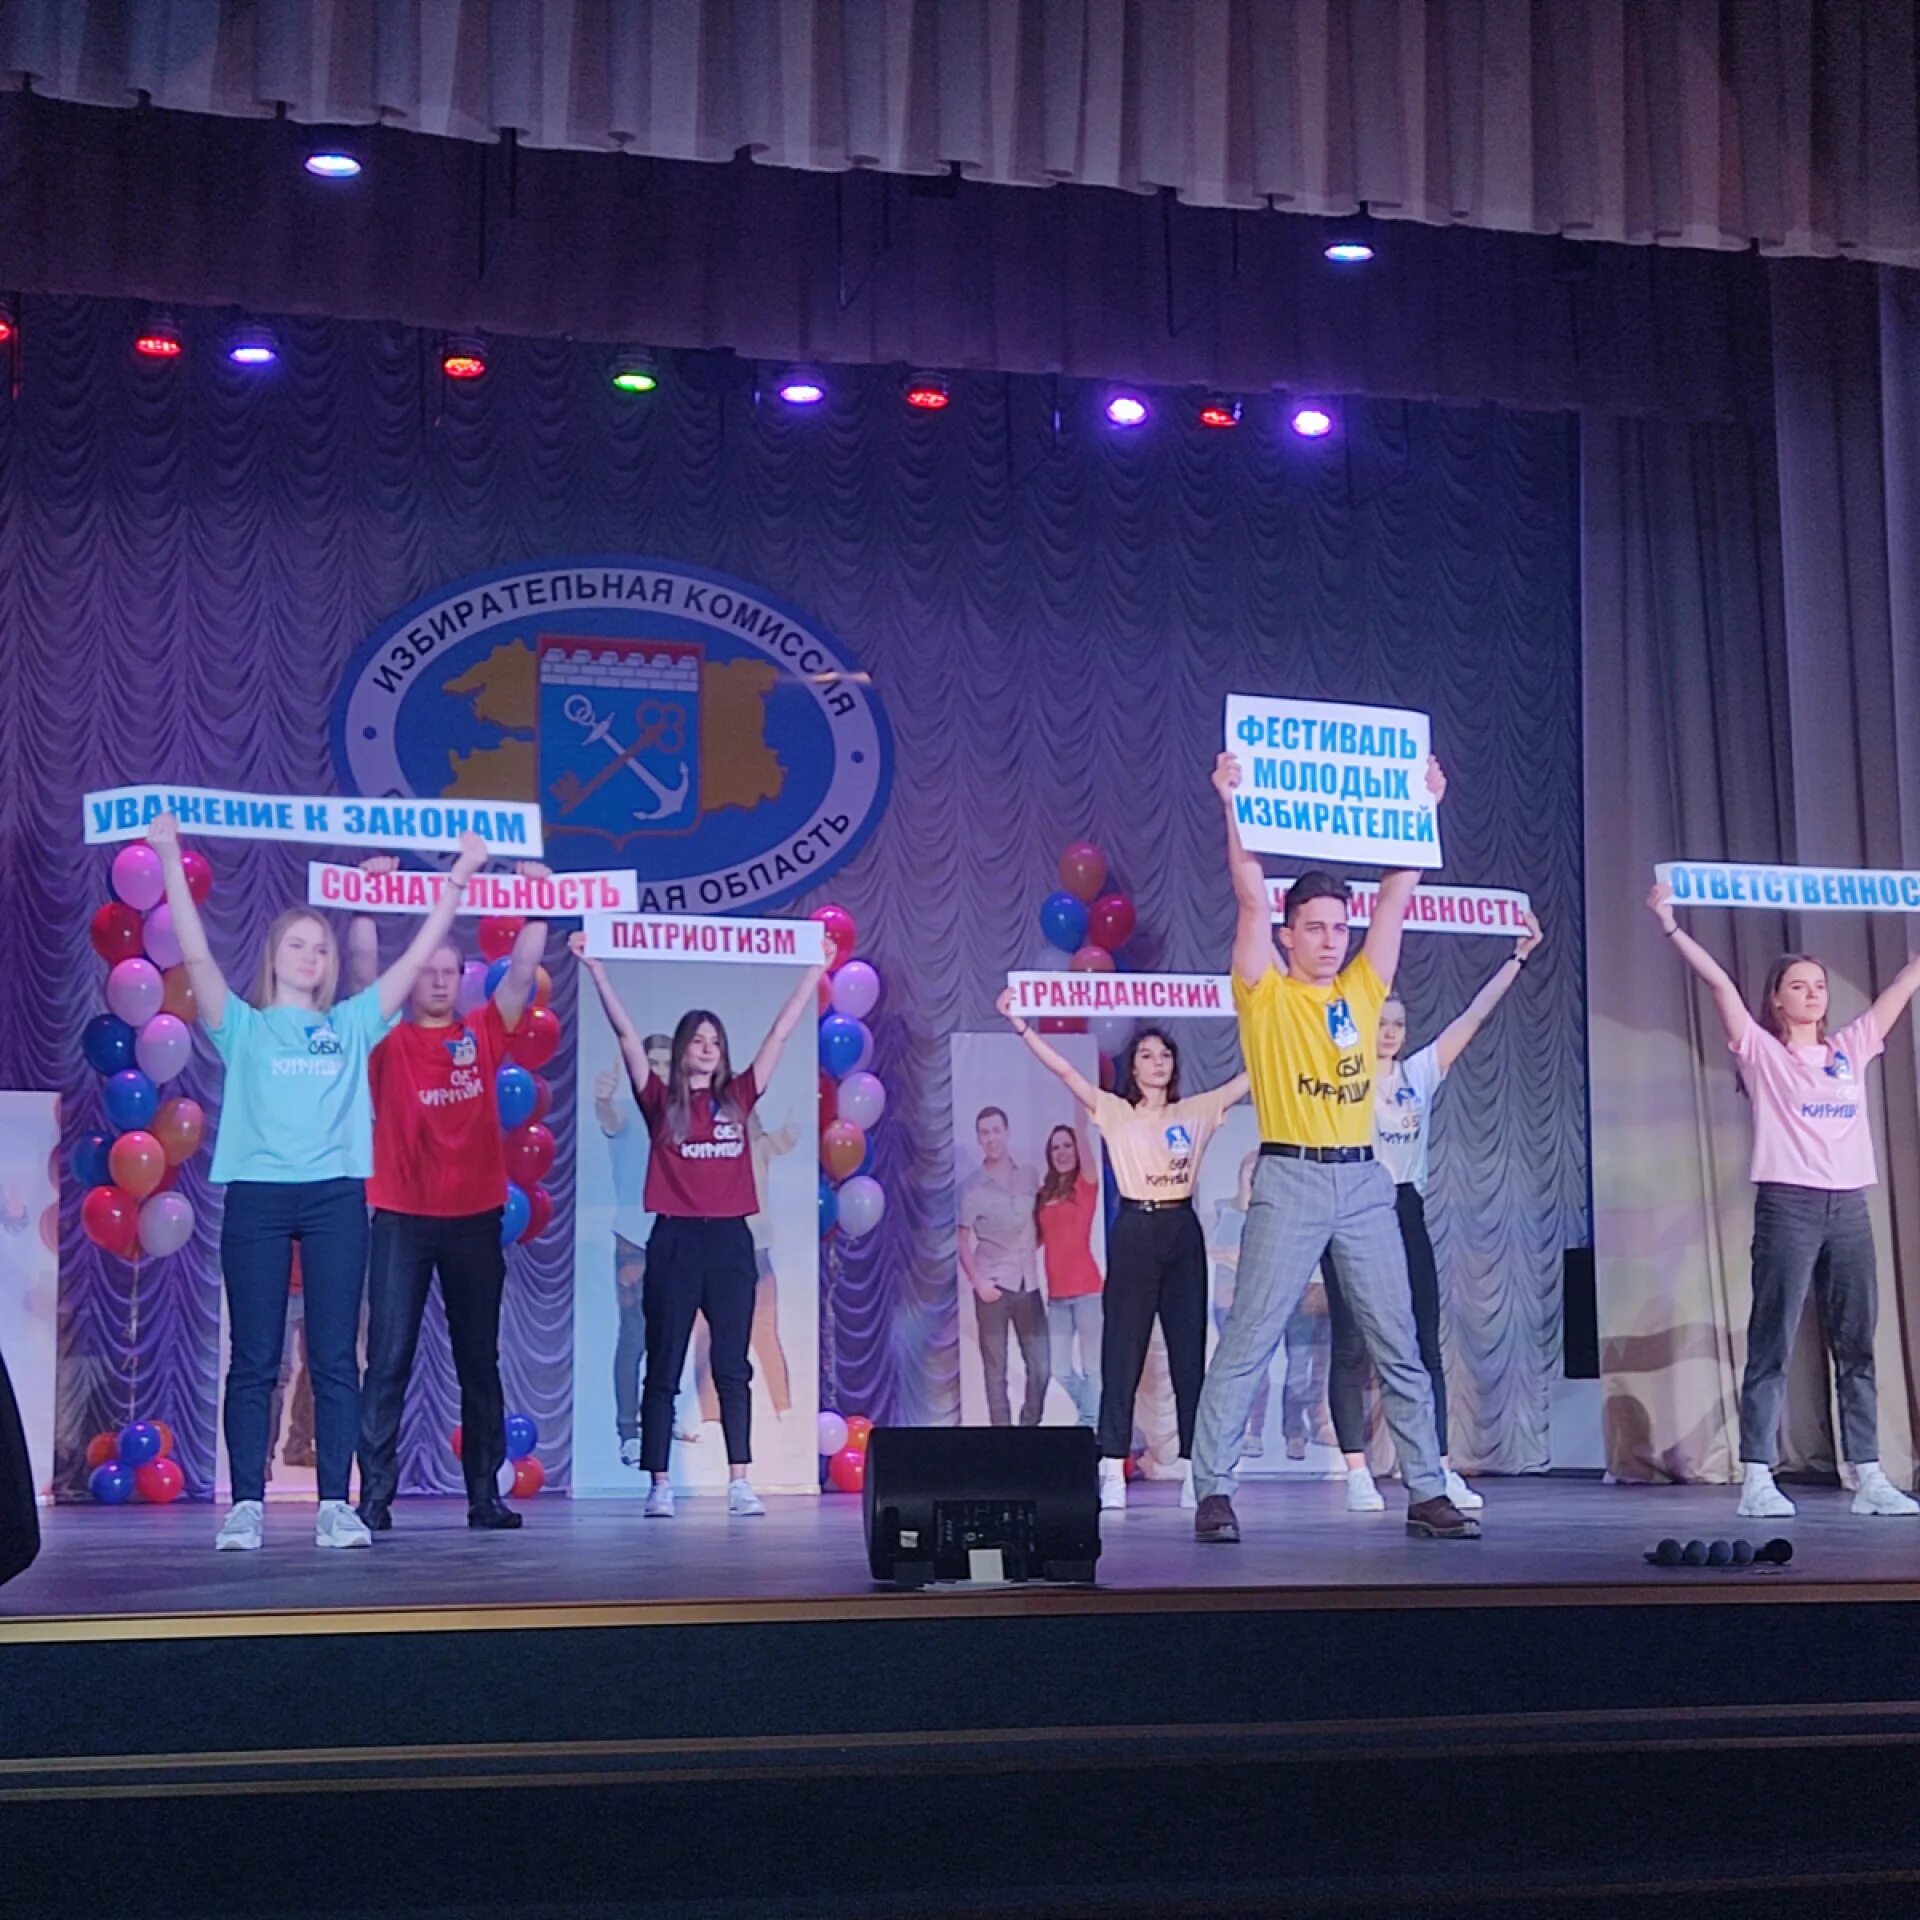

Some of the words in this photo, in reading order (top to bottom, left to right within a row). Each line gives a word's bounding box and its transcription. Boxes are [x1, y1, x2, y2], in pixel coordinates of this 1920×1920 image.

[372, 572, 674, 694] ИЗБИРАТЕЛЬНАЯ
[1236, 715, 1418, 760] ФЕСТИВАЛЬ
[1253, 757, 1410, 802] МОЛОДЫХ
[92, 794, 294, 834] УВАЖЕНИЕ
[303, 803, 329, 832] К
[343, 804, 527, 844] ЗАКОНАМ
[1234, 794, 1435, 843] ИЗБИРАТЕЛЕЙ
[699, 813, 850, 904] ОБЛАСТЬ
[321, 866, 621, 910] СОЗНАТЛЬНОСТЬ
[1670, 866, 1920, 907] ОТВЕТСТВЕННОС
[611, 921, 796, 955] ПАТРИОТИЗМ
[1019, 978, 1221, 1010] ГРАЖДАНСКИЙ
